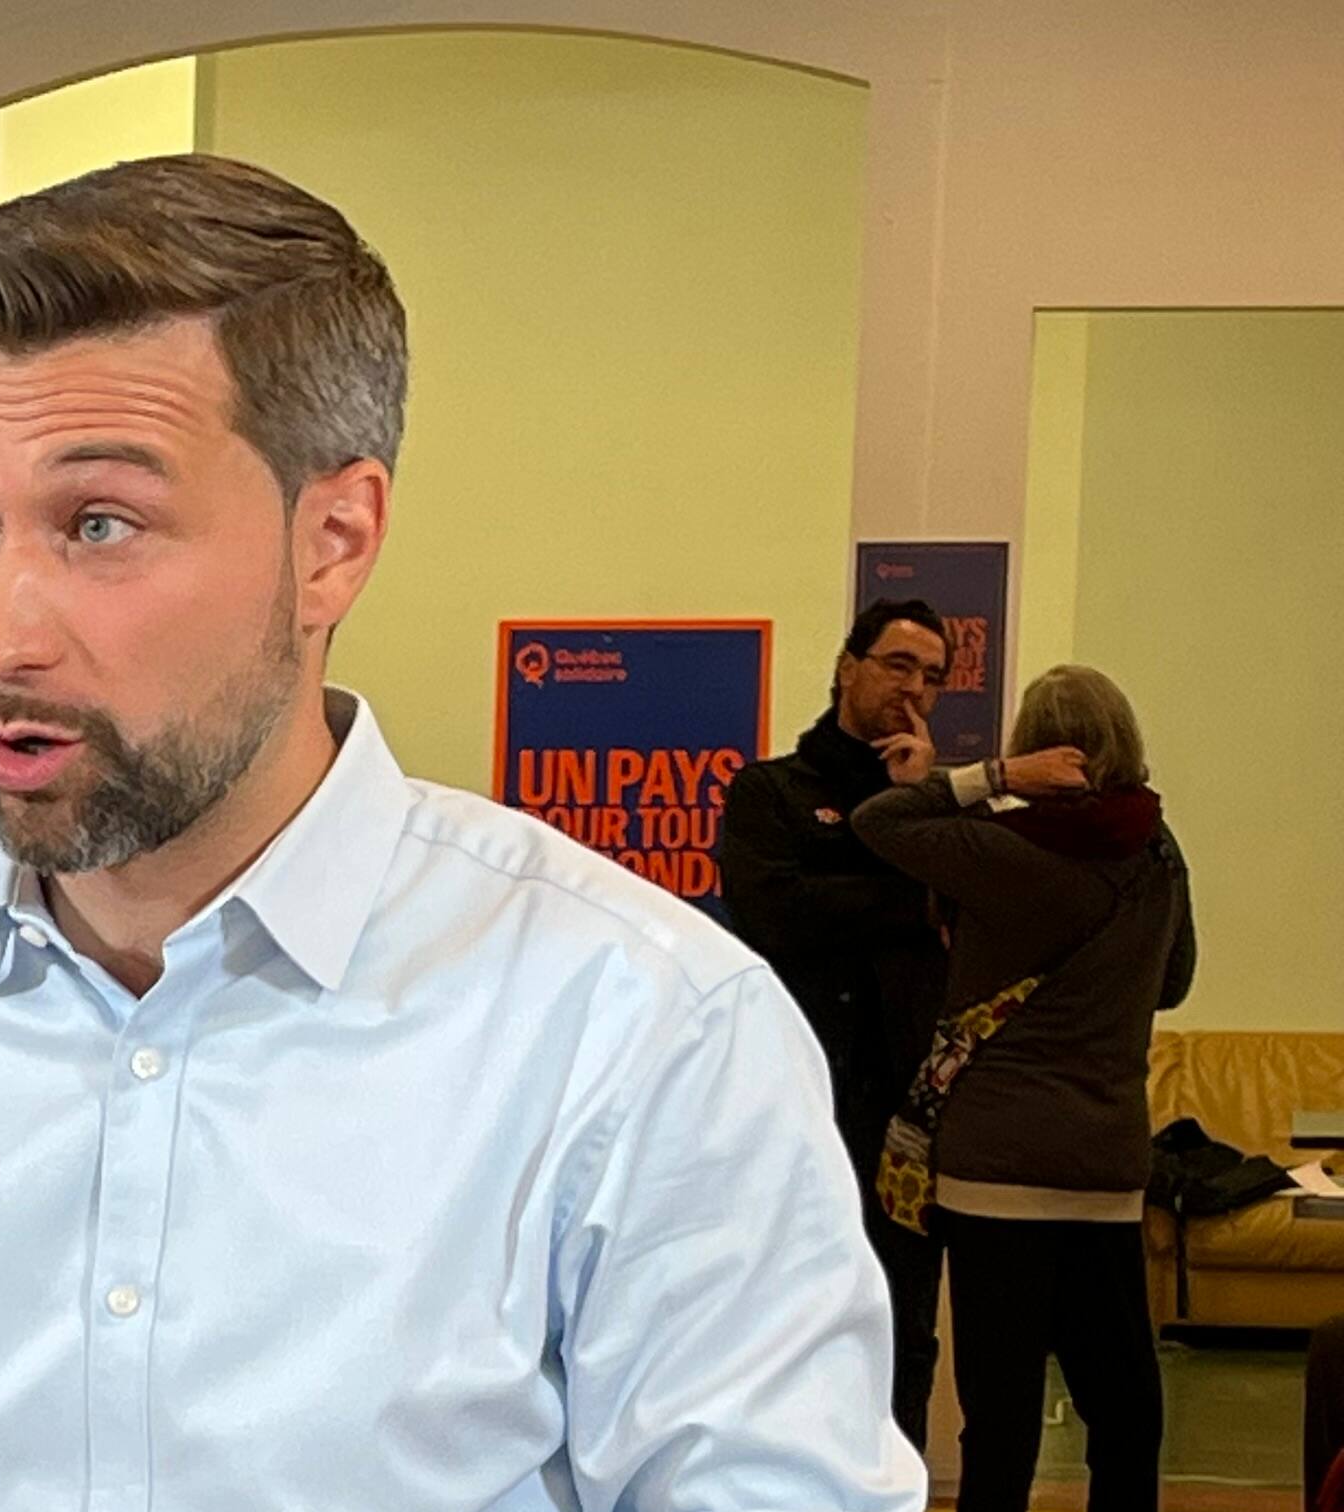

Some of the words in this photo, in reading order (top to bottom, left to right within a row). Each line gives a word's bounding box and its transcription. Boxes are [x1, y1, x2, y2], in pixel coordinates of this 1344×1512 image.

[518, 749, 597, 806] UN
[607, 747, 746, 806] PAYS
[637, 806, 724, 849] TOU
